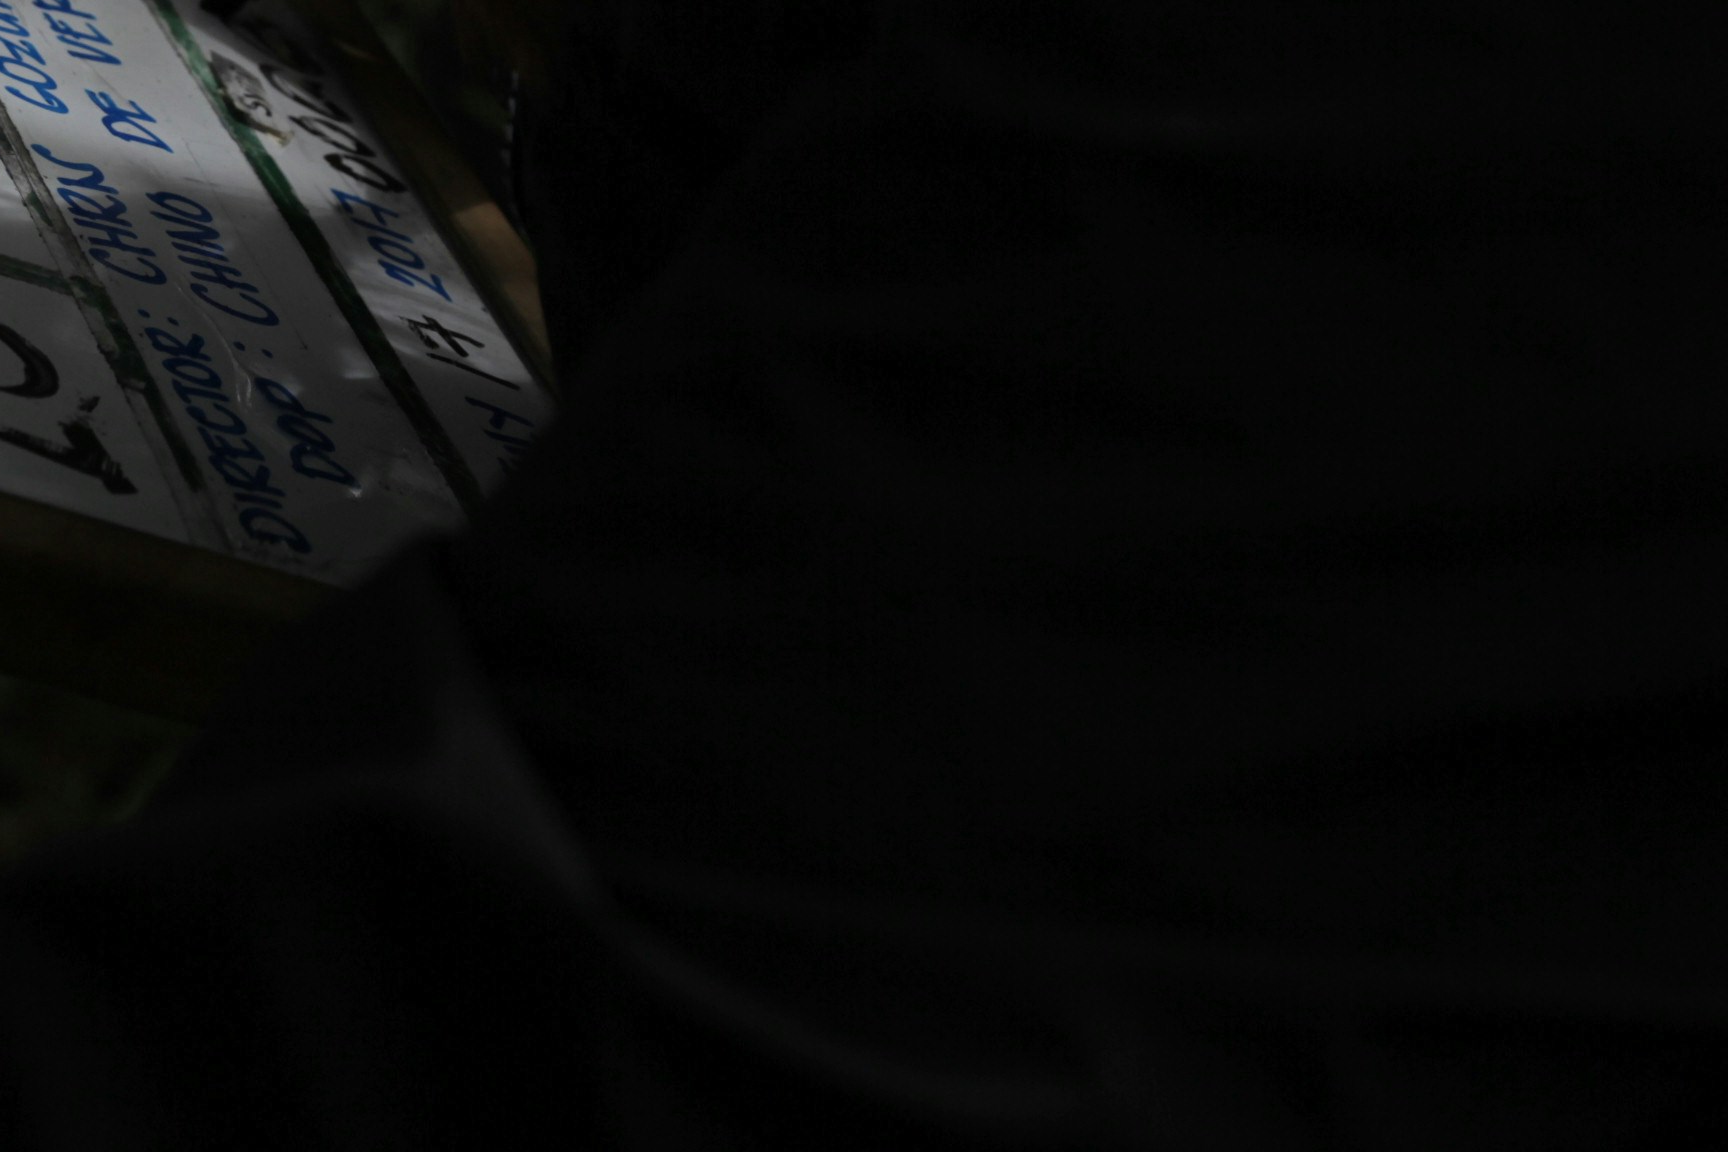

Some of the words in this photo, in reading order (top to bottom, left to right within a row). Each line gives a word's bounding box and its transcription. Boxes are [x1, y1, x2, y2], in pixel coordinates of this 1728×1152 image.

[85, 89, 173, 154] DE
[146, 191, 279, 326] CHINO
[330, 188, 452, 302] 2017
[138, 308, 312, 553] DIRECTOR:
